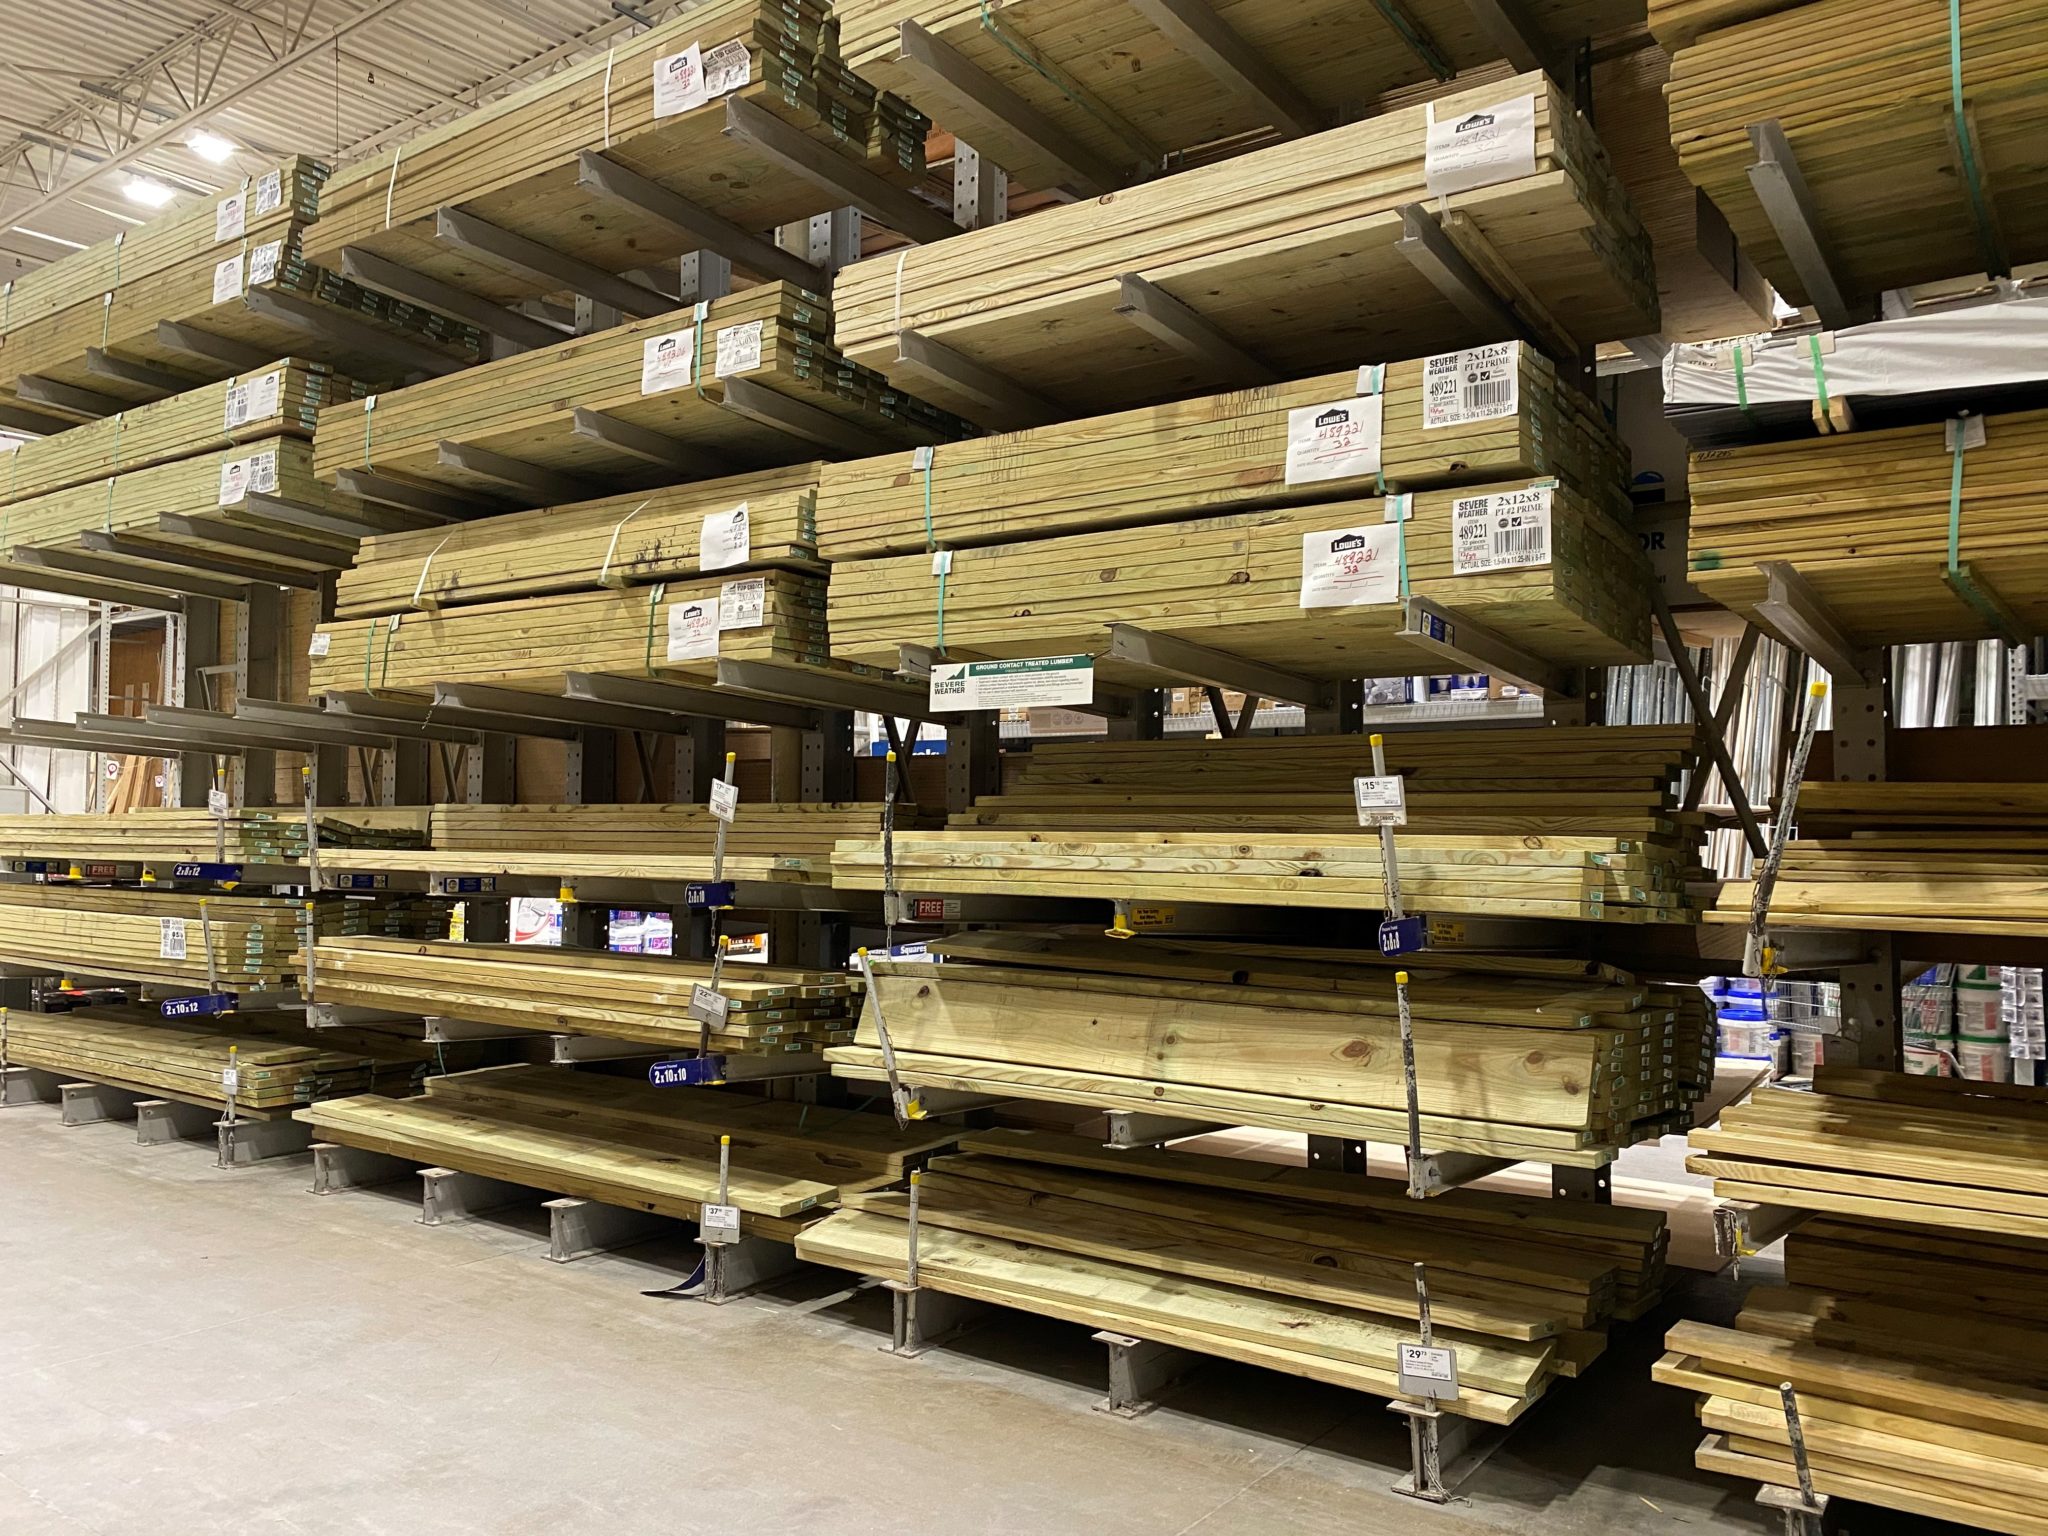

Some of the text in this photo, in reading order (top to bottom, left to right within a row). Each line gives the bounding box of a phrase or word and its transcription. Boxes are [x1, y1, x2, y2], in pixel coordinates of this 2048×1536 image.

[1459, 117, 1491, 131] LOWE'S
[1466, 346, 1508, 362] 2x12x8
[1429, 355, 1458, 369] SEVERE
[1465, 362, 1474, 371] PT
[1485, 356, 1511, 368] PRIME
[1428, 364, 1458, 376] WEATHER
[1429, 378, 1457, 397] 489221
[1318, 412, 1347, 426] LOWE'S
[1430, 415, 1449, 425] ACTUAL
[1458, 498, 1488, 511] SEVERE
[1497, 491, 1540, 508] 2x12x8
[1458, 507, 1488, 519] WEATHER
[1495, 503, 1544, 517] PT #2 PRIME
[1459, 523, 1488, 541] 489221
[1334, 538, 1362, 551] LOWE'S
[1335, 548, 1379, 566] 489221
[1344, 565, 1359, 575] 32
[1460, 560, 1480, 570] ACTUAL
[975, 663, 998, 671] GROUND
[999, 661, 1024, 669] CONTACT
[1025, 659, 1049, 667] TREATED
[1050, 657, 1074, 665] LUMBER
[934, 681, 966, 689] SEVERE
[934, 687, 966, 695] WEATHER
[92, 865, 115, 874] FREE
[919, 901, 942, 912] FREE
[900, 944, 927, 956] Squares
[166, 1003, 199, 1015] 2x10x12
[654, 1067, 687, 1084] 2x10x10
